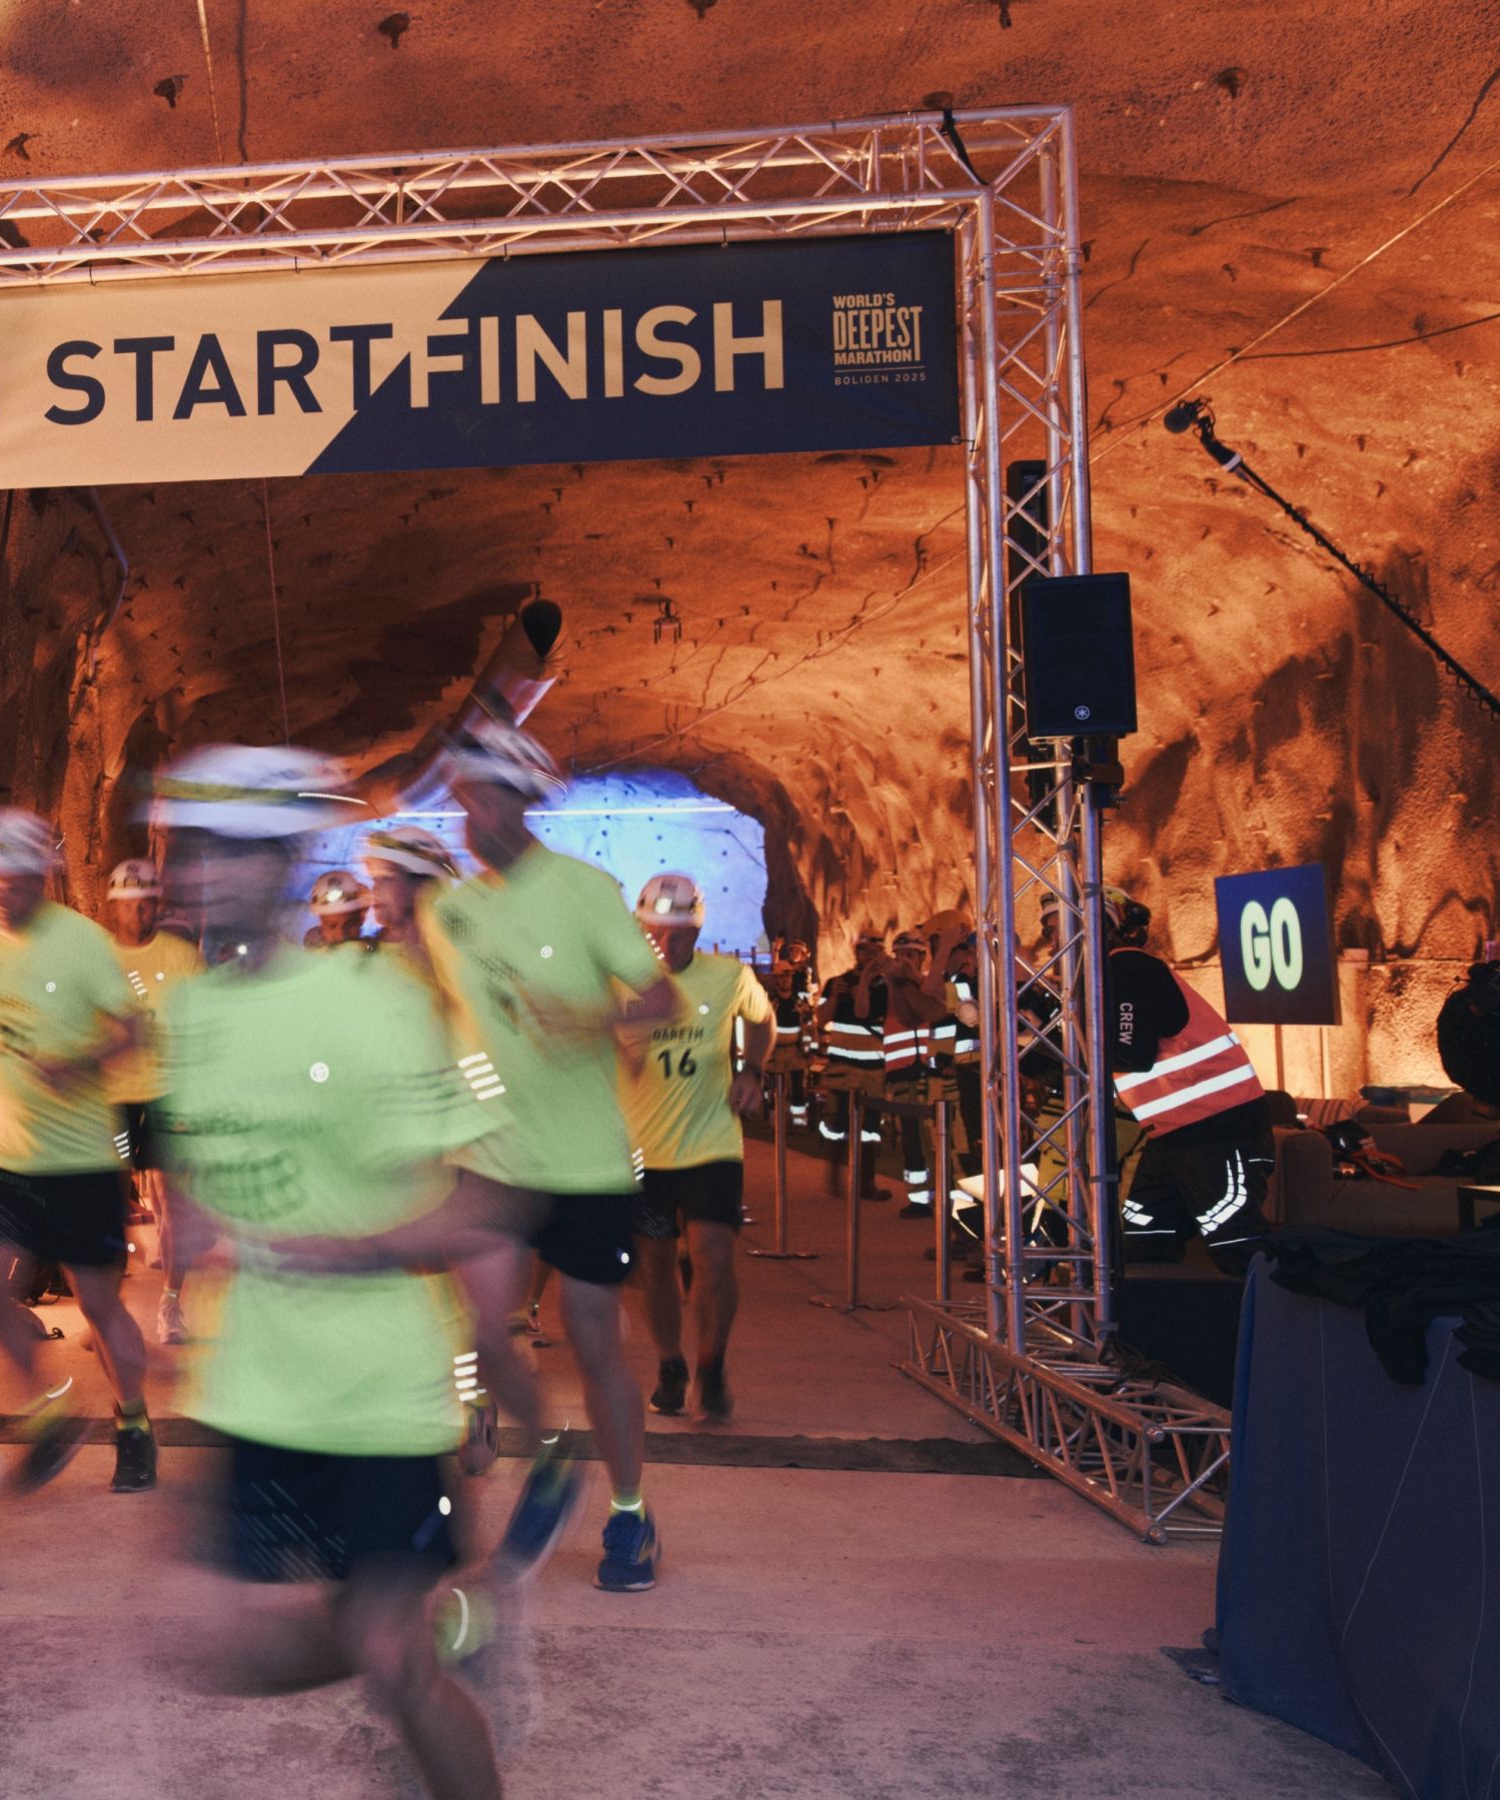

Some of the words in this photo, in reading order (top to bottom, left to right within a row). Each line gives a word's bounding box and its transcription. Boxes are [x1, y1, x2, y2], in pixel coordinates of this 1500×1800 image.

[832, 293, 896, 309] WORLD'S
[833, 305, 923, 361] DEEPEST
[44, 322, 394, 426] START
[409, 299, 785, 409] FINISH
[834, 349, 912, 365] MARATHON
[834, 374, 889, 386] BOLIDEN
[894, 372, 927, 383] 2025
[1240, 896, 1303, 992] GO
[1119, 1002, 1134, 1045] CREW
[656, 1047, 698, 1080] 16
